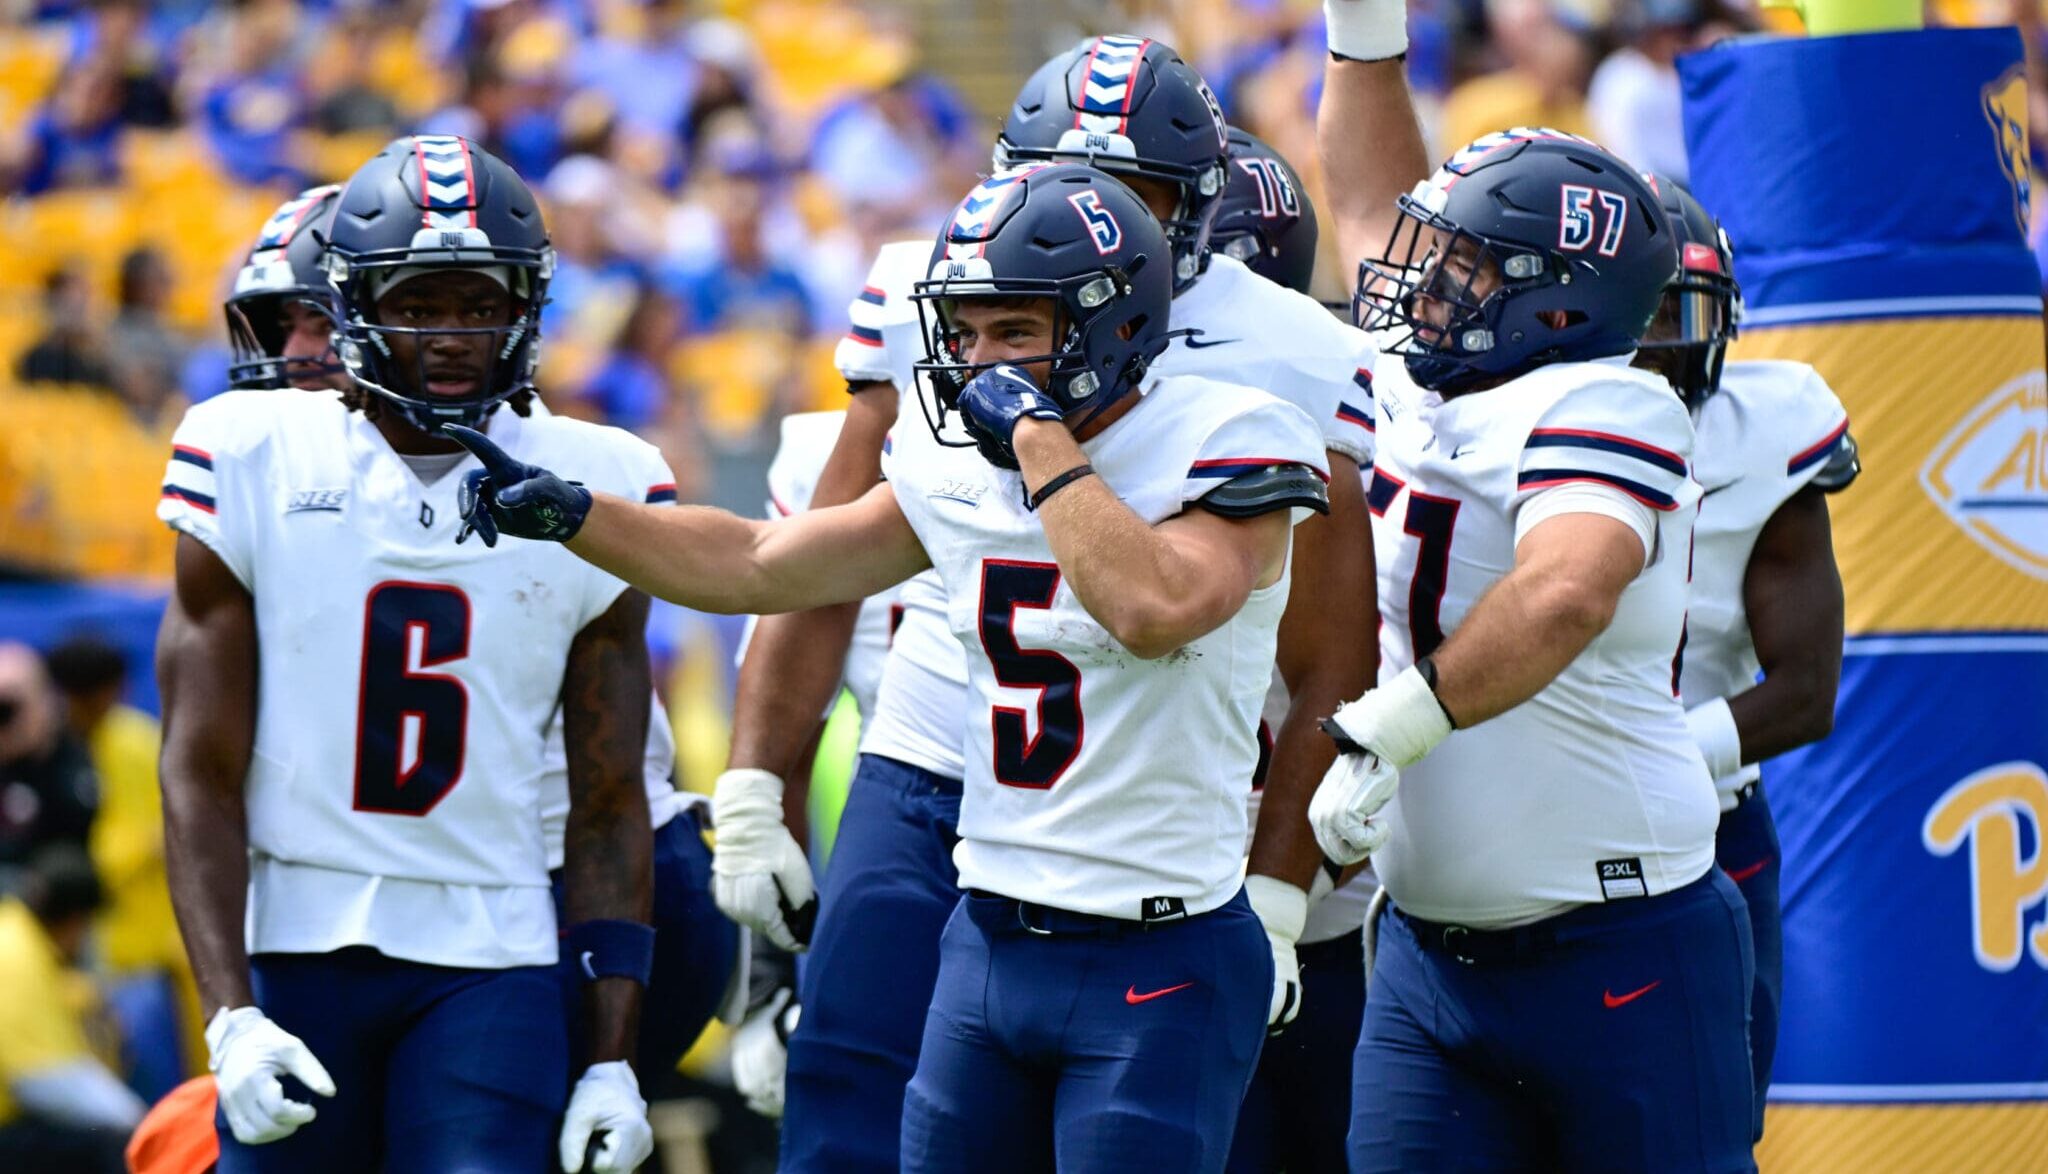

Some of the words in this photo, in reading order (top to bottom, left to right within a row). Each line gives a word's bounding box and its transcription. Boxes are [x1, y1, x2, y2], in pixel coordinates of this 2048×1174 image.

[1238, 158, 1300, 217] 78
[1560, 183, 1627, 257] 57
[1068, 190, 1123, 256] 5
[1978, 427, 2048, 493] A
[289, 490, 346, 508] NEC
[418, 500, 434, 529] D
[1369, 464, 1461, 664] 7
[353, 580, 473, 816] 6
[978, 558, 1084, 789] 5
[1602, 862, 1638, 877] 2XL
[1921, 760, 2048, 973] P
[1155, 898, 1171, 914] M
